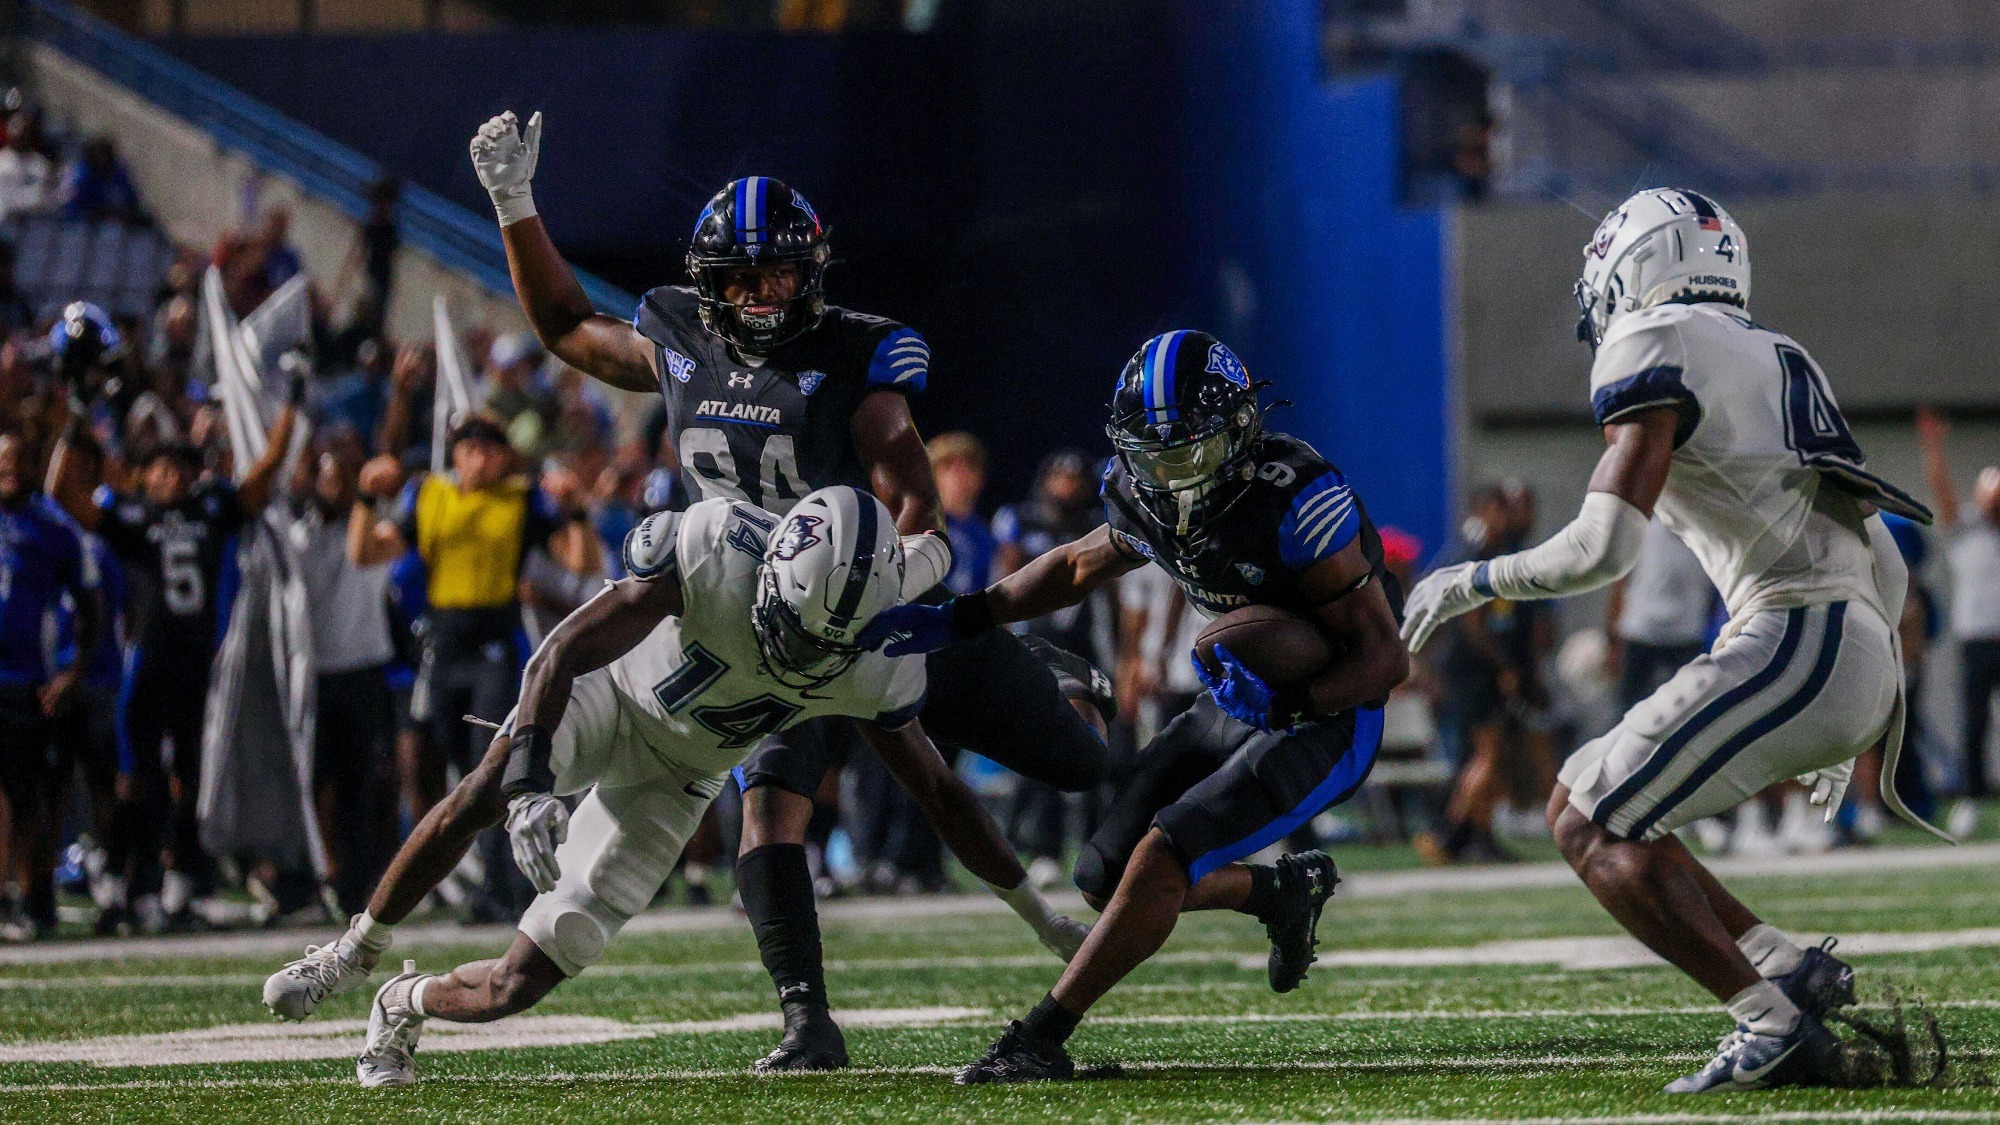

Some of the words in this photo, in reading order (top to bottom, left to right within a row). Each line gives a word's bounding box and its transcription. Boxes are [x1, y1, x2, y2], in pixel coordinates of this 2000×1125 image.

[1715, 233, 1734, 263] 4
[1689, 274, 1737, 289] HUSKIES
[695, 399, 781, 425] ATLANTA
[1775, 343, 1866, 467] 4
[1256, 461, 1297, 488] 9
[726, 505, 774, 562] 14
[652, 640, 806, 749] 14
